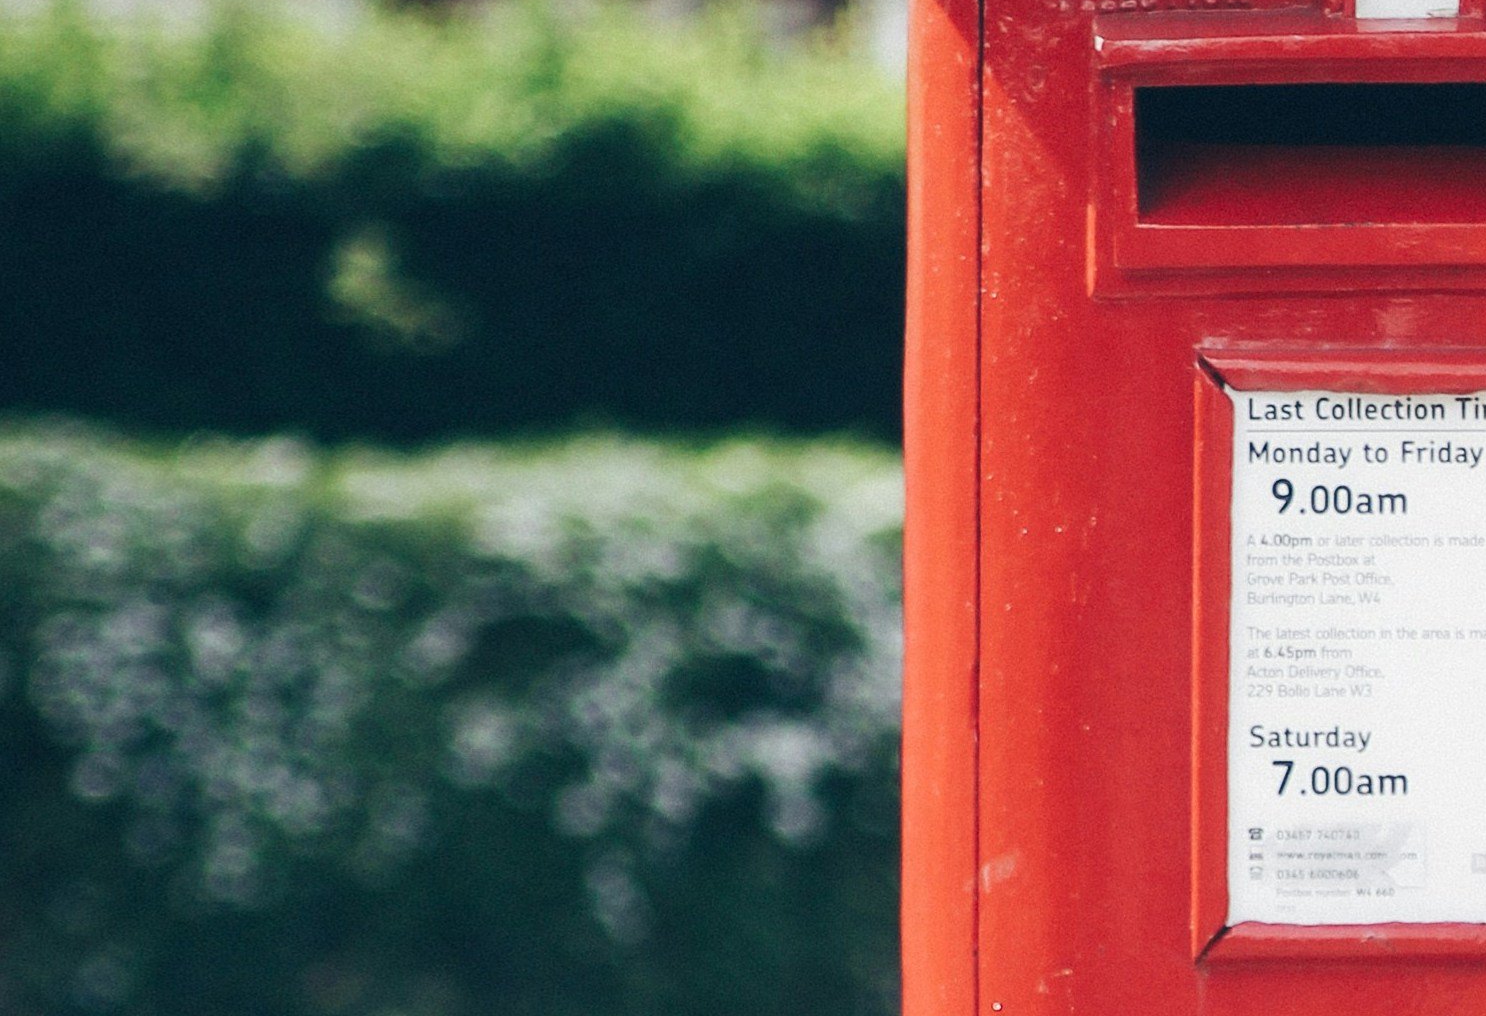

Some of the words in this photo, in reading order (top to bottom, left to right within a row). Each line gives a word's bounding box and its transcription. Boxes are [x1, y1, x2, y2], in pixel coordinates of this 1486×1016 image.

[1248, 397, 1304, 421] Last
[1315, 396, 1446, 421] Collection
[1248, 440, 1352, 469] Monday
[1362, 443, 1389, 464] to
[1400, 439, 1484, 469] Friday
[1271, 477, 1407, 515] 9.00am
[1260, 533, 1313, 549] 4.00pm
[1334, 534, 1365, 547] later
[1368, 533, 1430, 548] collection
[1447, 534, 1486, 547] made
[1245, 553, 1278, 567] from
[1281, 553, 1303, 566] the
[1306, 551, 1359, 567] Postbox
[1245, 571, 1284, 587] Grove
[1288, 571, 1318, 586] Park
[1321, 571, 1351, 586] Post
[1246, 590, 1315, 607] Burlington
[1357, 591, 1381, 604] W4
[1246, 625, 1271, 640] The
[1275, 627, 1311, 641] latest
[1315, 626, 1376, 641] collection
[1395, 626, 1418, 640] the
[1421, 629, 1451, 640] area
[1263, 645, 1317, 661] 6.45pm
[1320, 645, 1353, 659] from
[1245, 664, 1284, 679] Acton
[1287, 664, 1341, 680] Delivery
[1246, 683, 1274, 698] 229
[1276, 683, 1310, 698] Bollo
[1313, 684, 1347, 698] Lane
[1349, 682, 1372, 698] W3
[1249, 724, 1371, 753] Saturday
[1271, 759, 1408, 796] 7.00am
